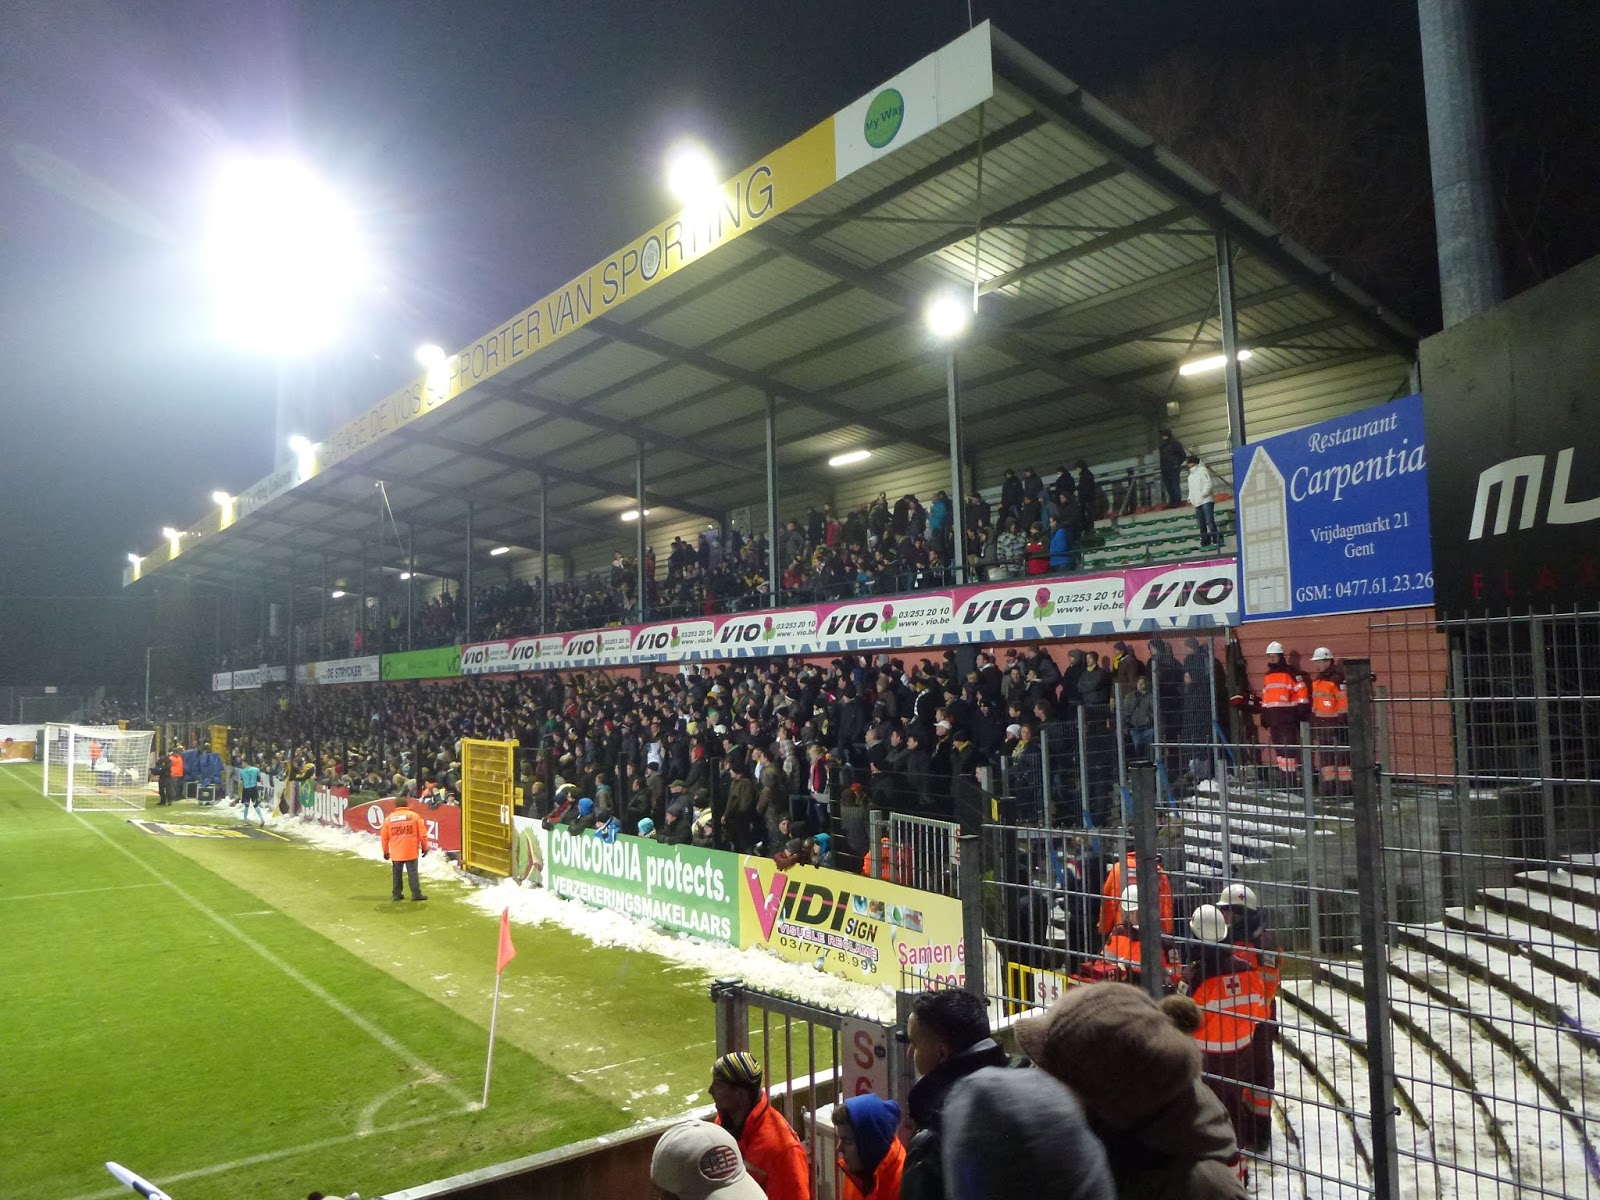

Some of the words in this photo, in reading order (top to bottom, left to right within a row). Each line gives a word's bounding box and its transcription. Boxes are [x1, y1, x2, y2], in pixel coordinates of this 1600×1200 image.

[866, 118, 879, 131] My
[881, 106, 902, 123] Way
[427, 310, 541, 406] SPPORTER
[548, 276, 591, 335] VAN
[1308, 412, 1398, 453] Restaurant
[1290, 438, 1427, 502] Carpentia
[1310, 516, 1390, 544] Vrijdagmarkt
[1393, 512, 1409, 528] 21
[1344, 542, 1375, 558] Gent
[1057, 593, 1092, 604] 03/253
[1094, 591, 1108, 600] 20
[1112, 590, 1125, 599] 10
[1142, 577, 1234, 610] VIO
[1296, 584, 1332, 603] GSM:
[1335, 571, 1434, 598] 0477.61.23.26
[899, 609, 924, 619] 03/253
[926, 608, 937, 616] 20
[940, 607, 950, 615] 10
[962, 597, 1030, 625] VIO
[720, 623, 761, 644] VIO
[798, 620, 806, 628] 20
[826, 612, 879, 635] VIO
[511, 645, 534, 661] VIO
[567, 639, 595, 656] VIO
[637, 632, 668, 651] VIO
[463, 651, 483, 665] VIO
[551, 828, 642, 883] CONCORDIA
[646, 850, 731, 903] protects.
[551, 874, 731, 939] VERZEKERINGSMAKELAARS
[779, 922, 825, 944] VISUELE
[845, 917, 878, 943] SIGN
[898, 942, 951, 966] Samen
[853, 1030, 874, 1070] S
